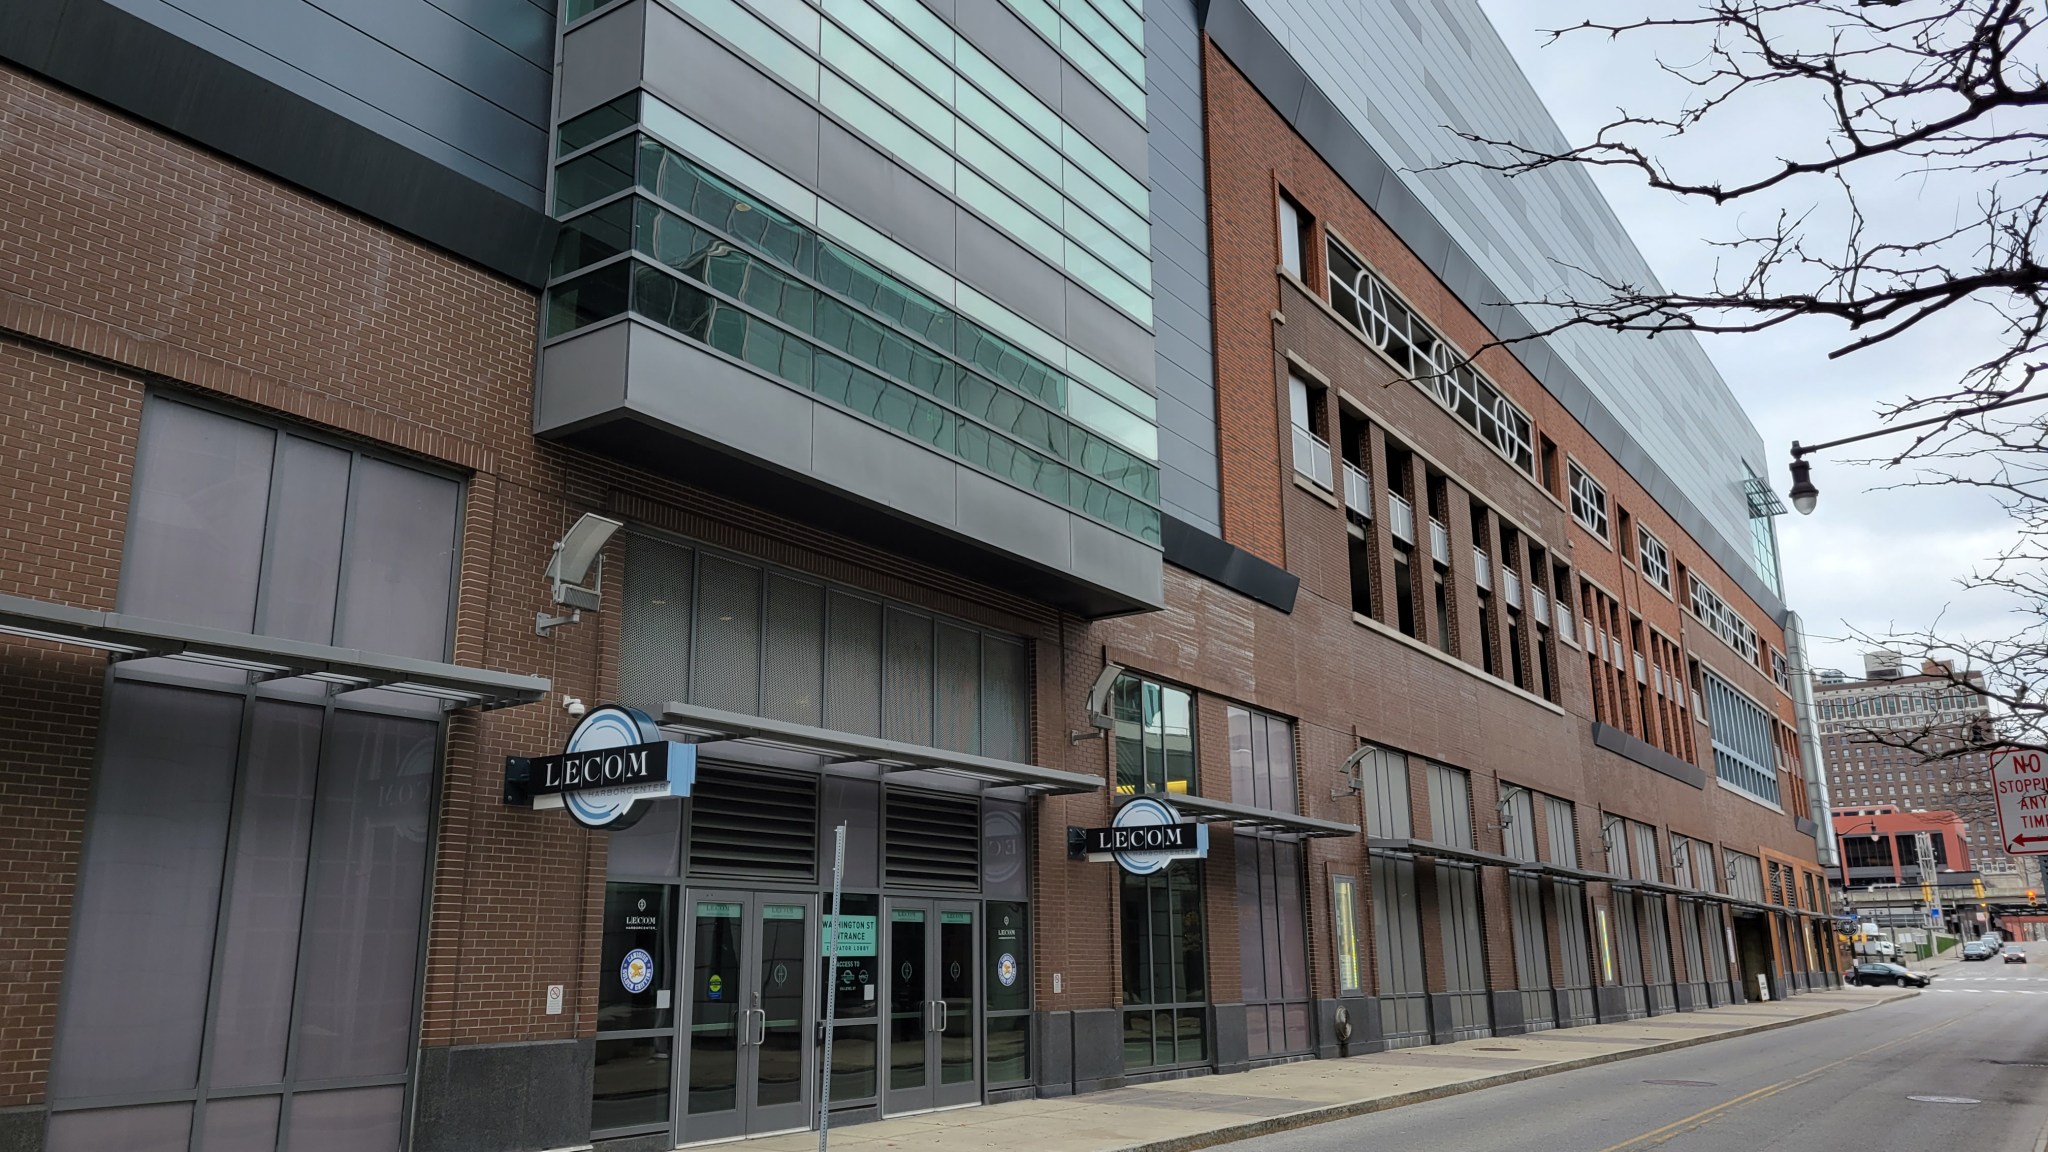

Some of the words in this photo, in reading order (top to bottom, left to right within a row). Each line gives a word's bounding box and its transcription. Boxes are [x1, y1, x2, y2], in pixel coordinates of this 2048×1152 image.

[545, 750, 649, 787] LECOM
[2013, 753, 2041, 775] NO
[587, 782, 666, 798] HARBORCENTER
[1999, 777, 2048, 794] STOPPI
[2020, 796, 2048, 811] ANY
[1099, 828, 1183, 849] LECOM
[626, 916, 656, 925] LECOM
[822, 920, 865, 929] WAHINGTON
[866, 921, 875, 929] ST
[836, 960, 854, 968] ACCESS
